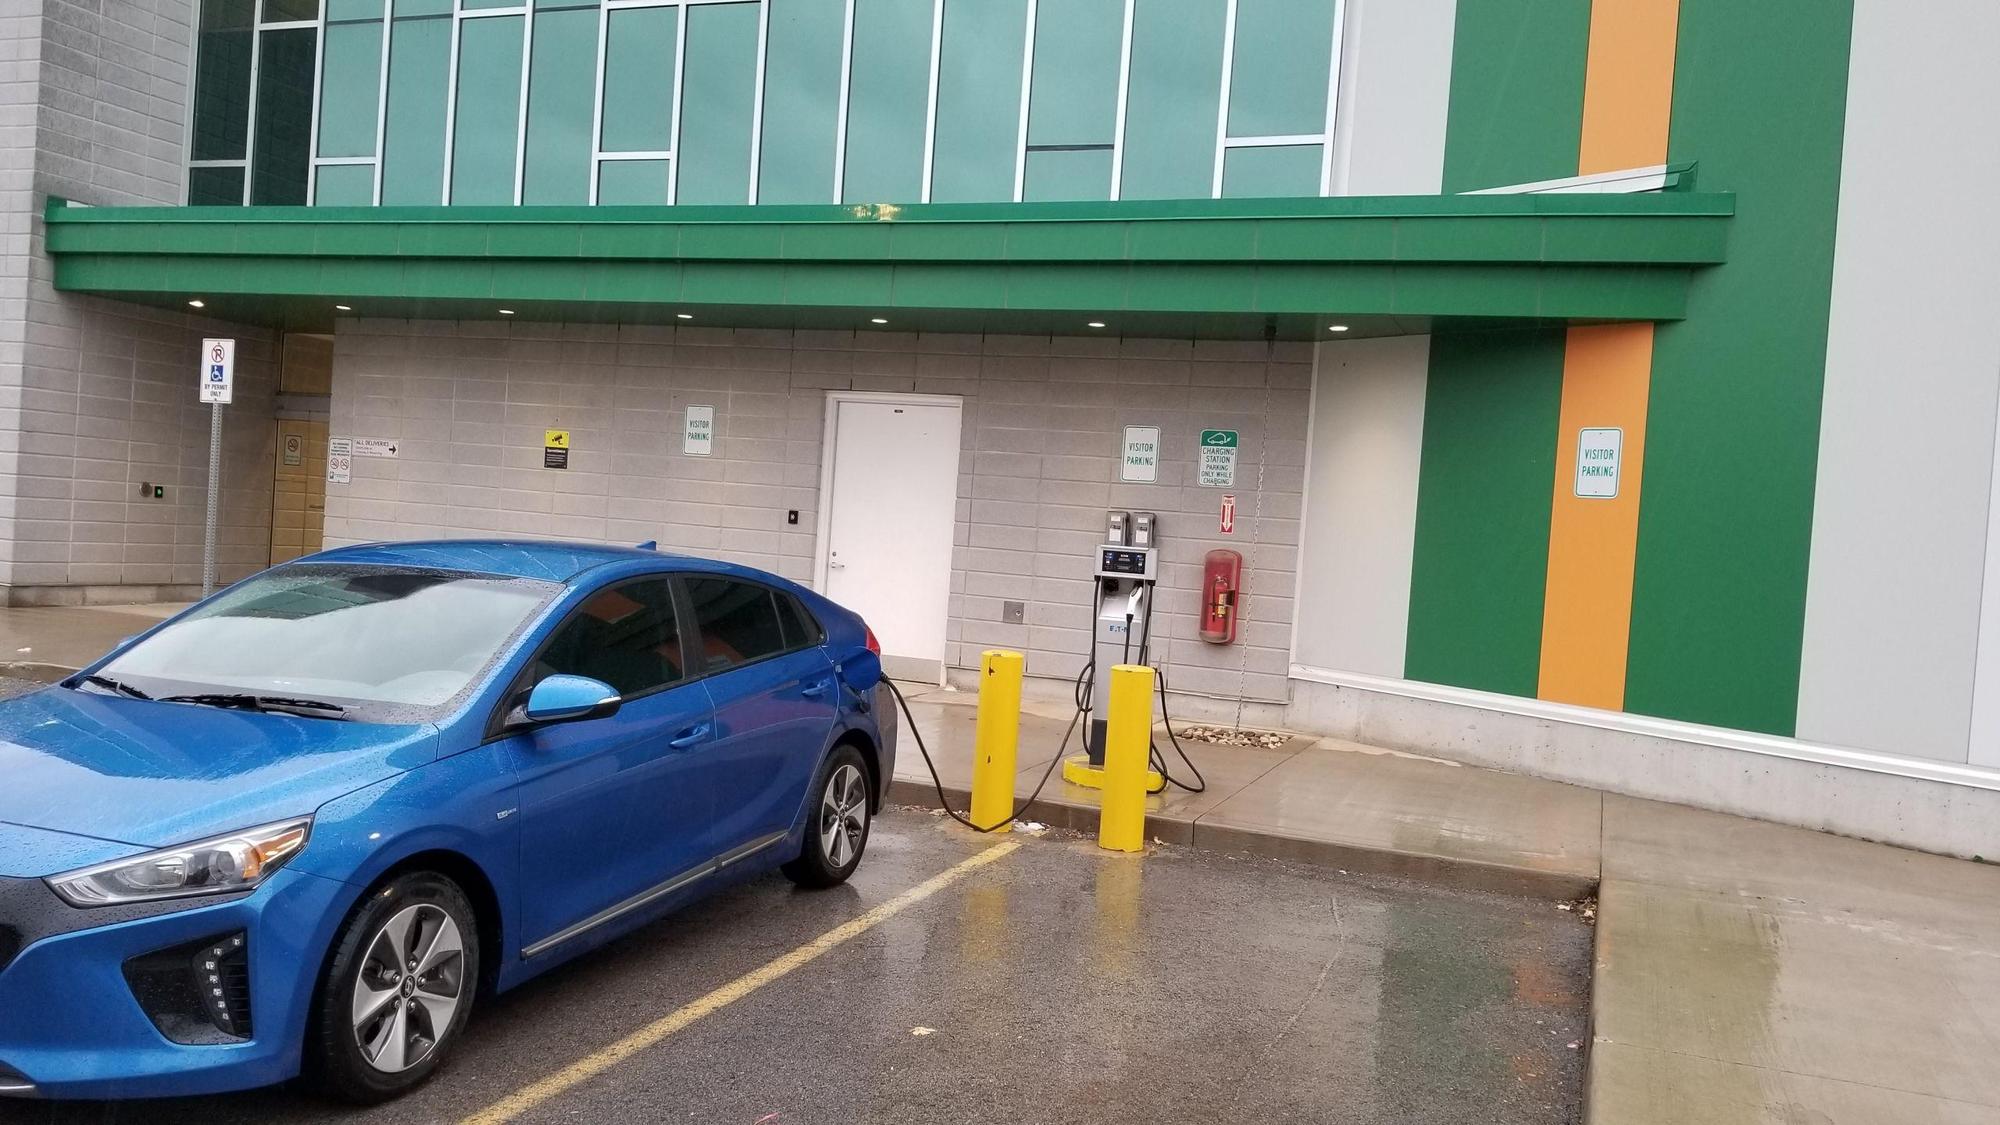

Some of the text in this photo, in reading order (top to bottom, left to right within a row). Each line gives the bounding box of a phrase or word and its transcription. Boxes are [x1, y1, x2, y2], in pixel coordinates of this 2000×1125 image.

[690, 419, 710, 428] VISITOR
[687, 432, 710, 440] PARKING
[1129, 442, 1153, 452] VISITOR
[1202, 447, 1235, 455] CHARGING
[1205, 455, 1230, 463] STATION
[1585, 449, 1614, 460] VISITOR
[1127, 456, 1153, 466] PARKING
[1582, 466, 1613, 477] PARKING
